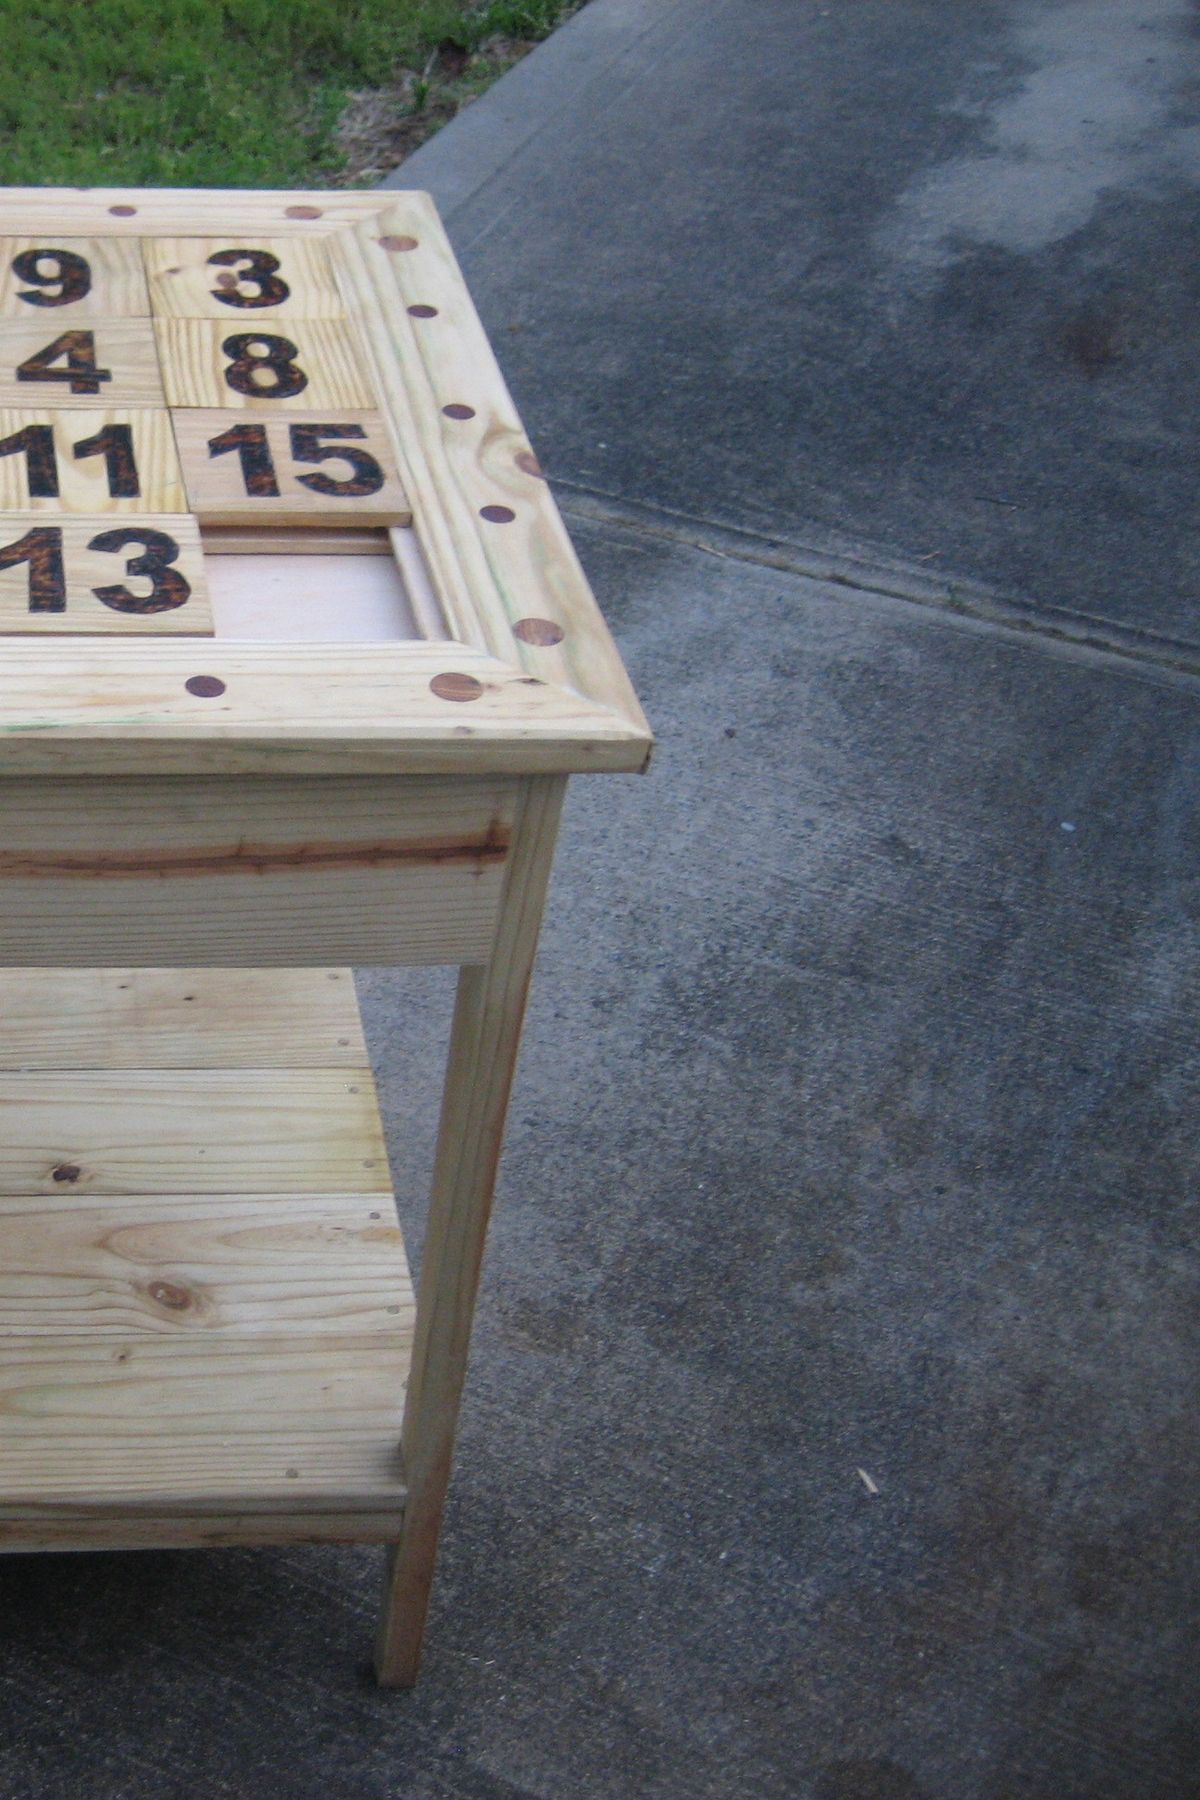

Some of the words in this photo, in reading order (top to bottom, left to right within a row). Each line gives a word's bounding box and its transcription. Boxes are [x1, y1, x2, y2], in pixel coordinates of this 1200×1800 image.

[11, 248, 92, 308] 9
[206, 249, 290, 309] 3
[16, 330, 112, 394] 4
[222, 332, 309, 399] 8
[207, 423, 385, 498] 15
